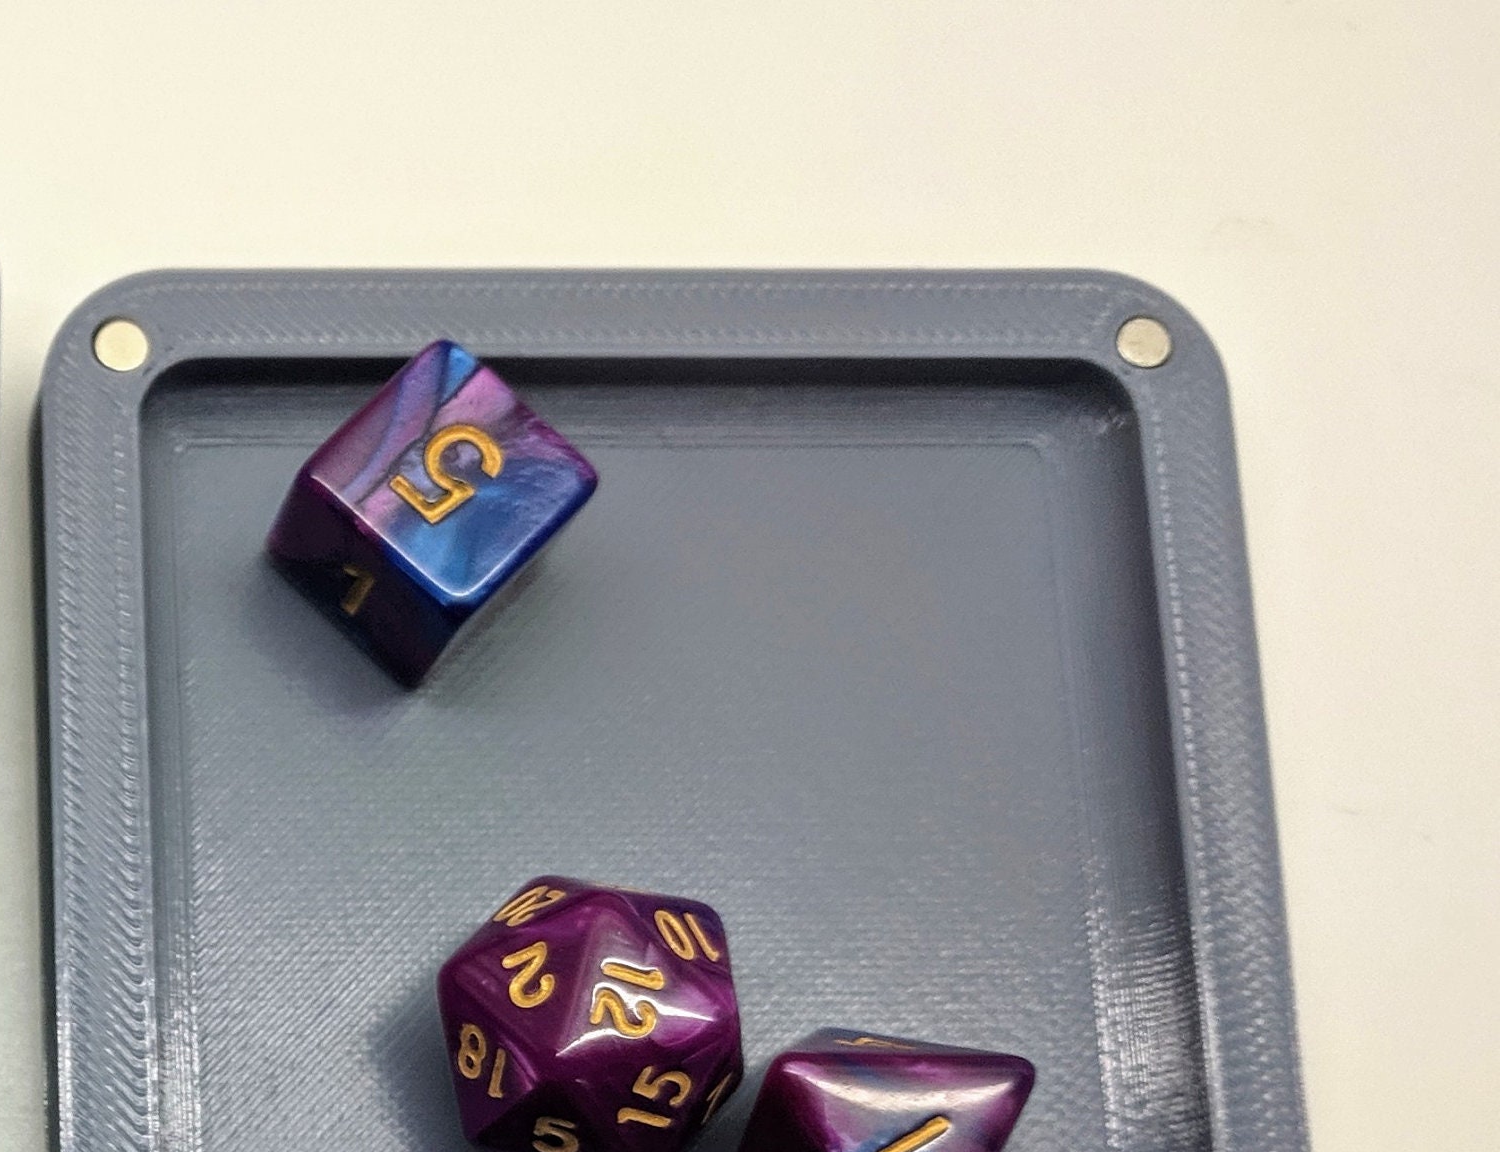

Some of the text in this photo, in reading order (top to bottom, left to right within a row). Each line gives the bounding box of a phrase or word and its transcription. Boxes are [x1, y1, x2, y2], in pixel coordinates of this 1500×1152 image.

[389, 424, 504, 525] 5
[652, 908, 721, 963] 10
[501, 940, 557, 1010] 2
[589, 958, 666, 1040] 12
[457, 1023, 507, 1099] 18
[616, 1064, 694, 1129] 15
